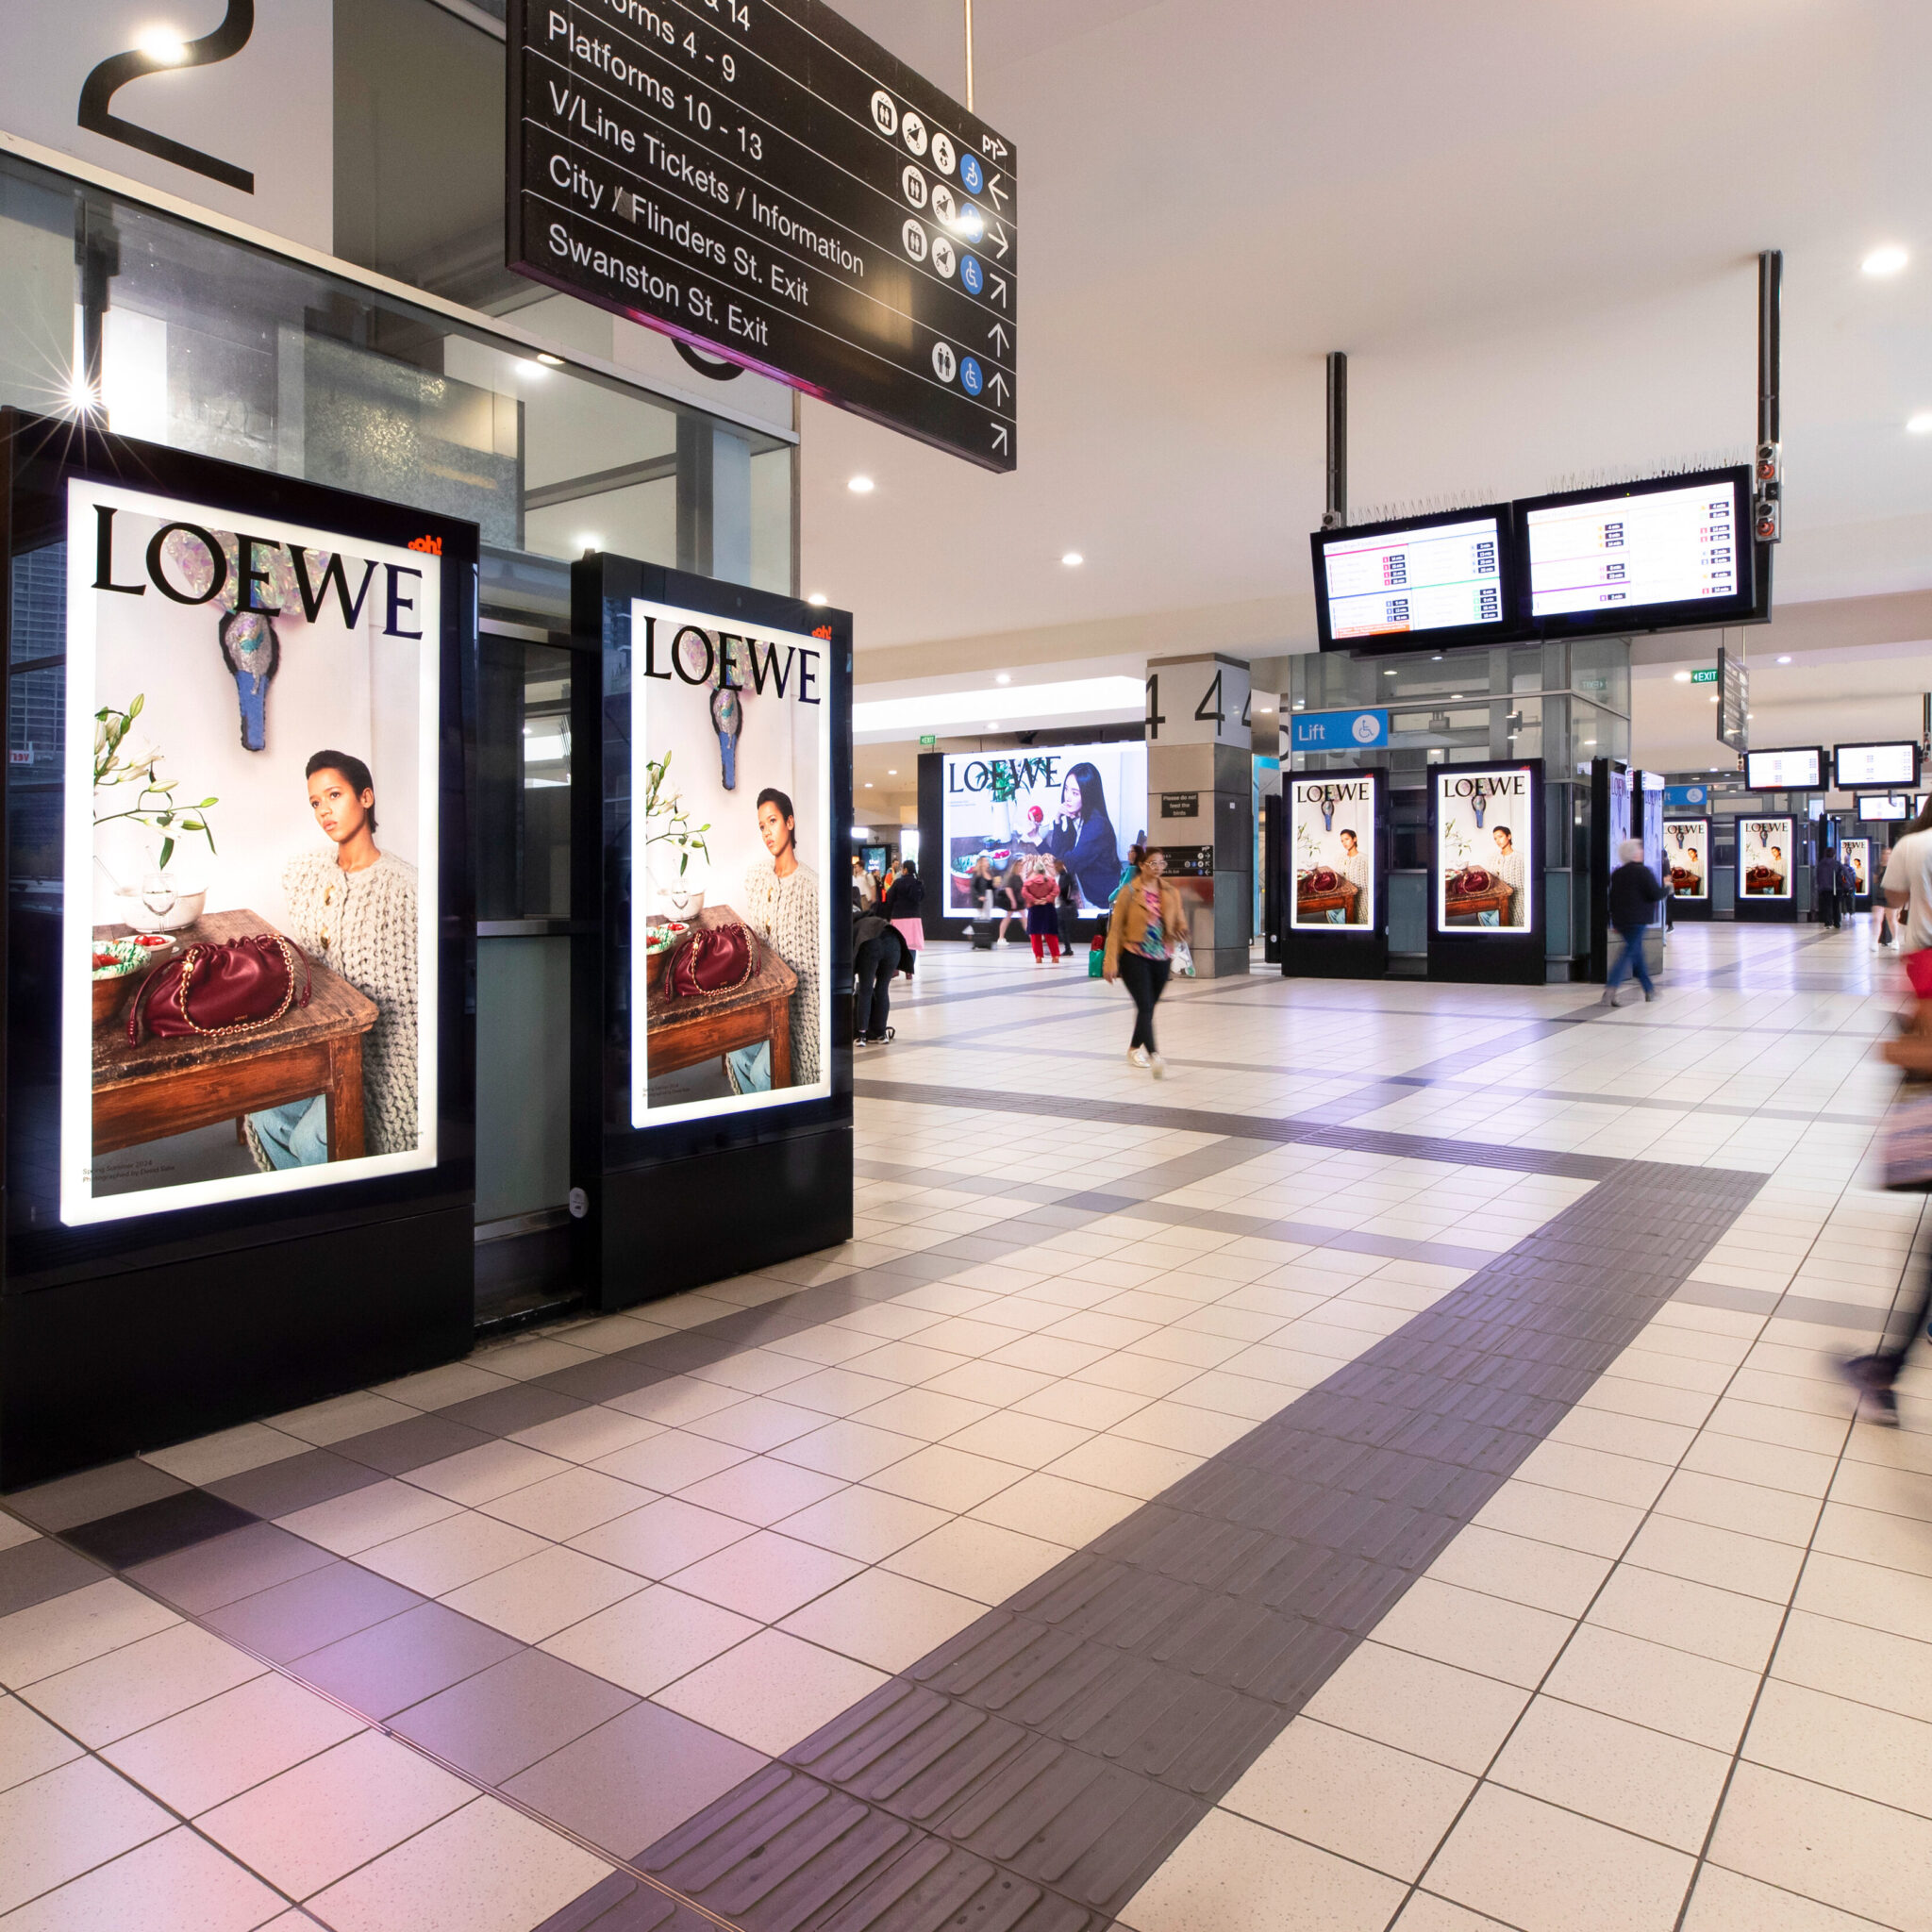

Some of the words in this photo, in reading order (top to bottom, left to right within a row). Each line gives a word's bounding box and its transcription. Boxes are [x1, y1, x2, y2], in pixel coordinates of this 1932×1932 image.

[727, 0, 751, 32] 14
[604, 0, 675, 45] orms
[683, 31, 697, 58] 4
[706, 55, 714, 63] -
[722, 54, 736, 82] 9
[549, 9, 675, 110] Platforms
[684, 94, 711, 130] 10
[720, 125, 728, 134] -
[738, 125, 762, 160] 13
[549, 80, 636, 153] V/Line
[643, 132, 729, 204] Tickets
[736, 187, 746, 210] /
[752, 192, 864, 276] Information
[549, 155, 604, 209] City
[611, 186, 623, 212] /
[632, 192, 726, 265] Flinders
[734, 246, 762, 283] St.
[771, 264, 808, 306] Exit
[549, 224, 679, 307] Swanston
[688, 287, 719, 325] St.
[728, 304, 768, 346] Exit
[92, 504, 424, 641] LOEWE
[643, 615, 821, 706] LOEWE
[1698, 671, 1717, 682] EXIT
[1194, 669, 1225, 736] 4
[1298, 724, 1325, 741] Lift
[949, 756, 1062, 793] LOEWE
[1297, 783, 1370, 803] LOEWE
[1444, 775, 1525, 798] LOEWE
[1664, 824, 1705, 835] OEWE
[1745, 822, 1789, 833] LOEWE
[107, 1163, 134, 1172] Summer
